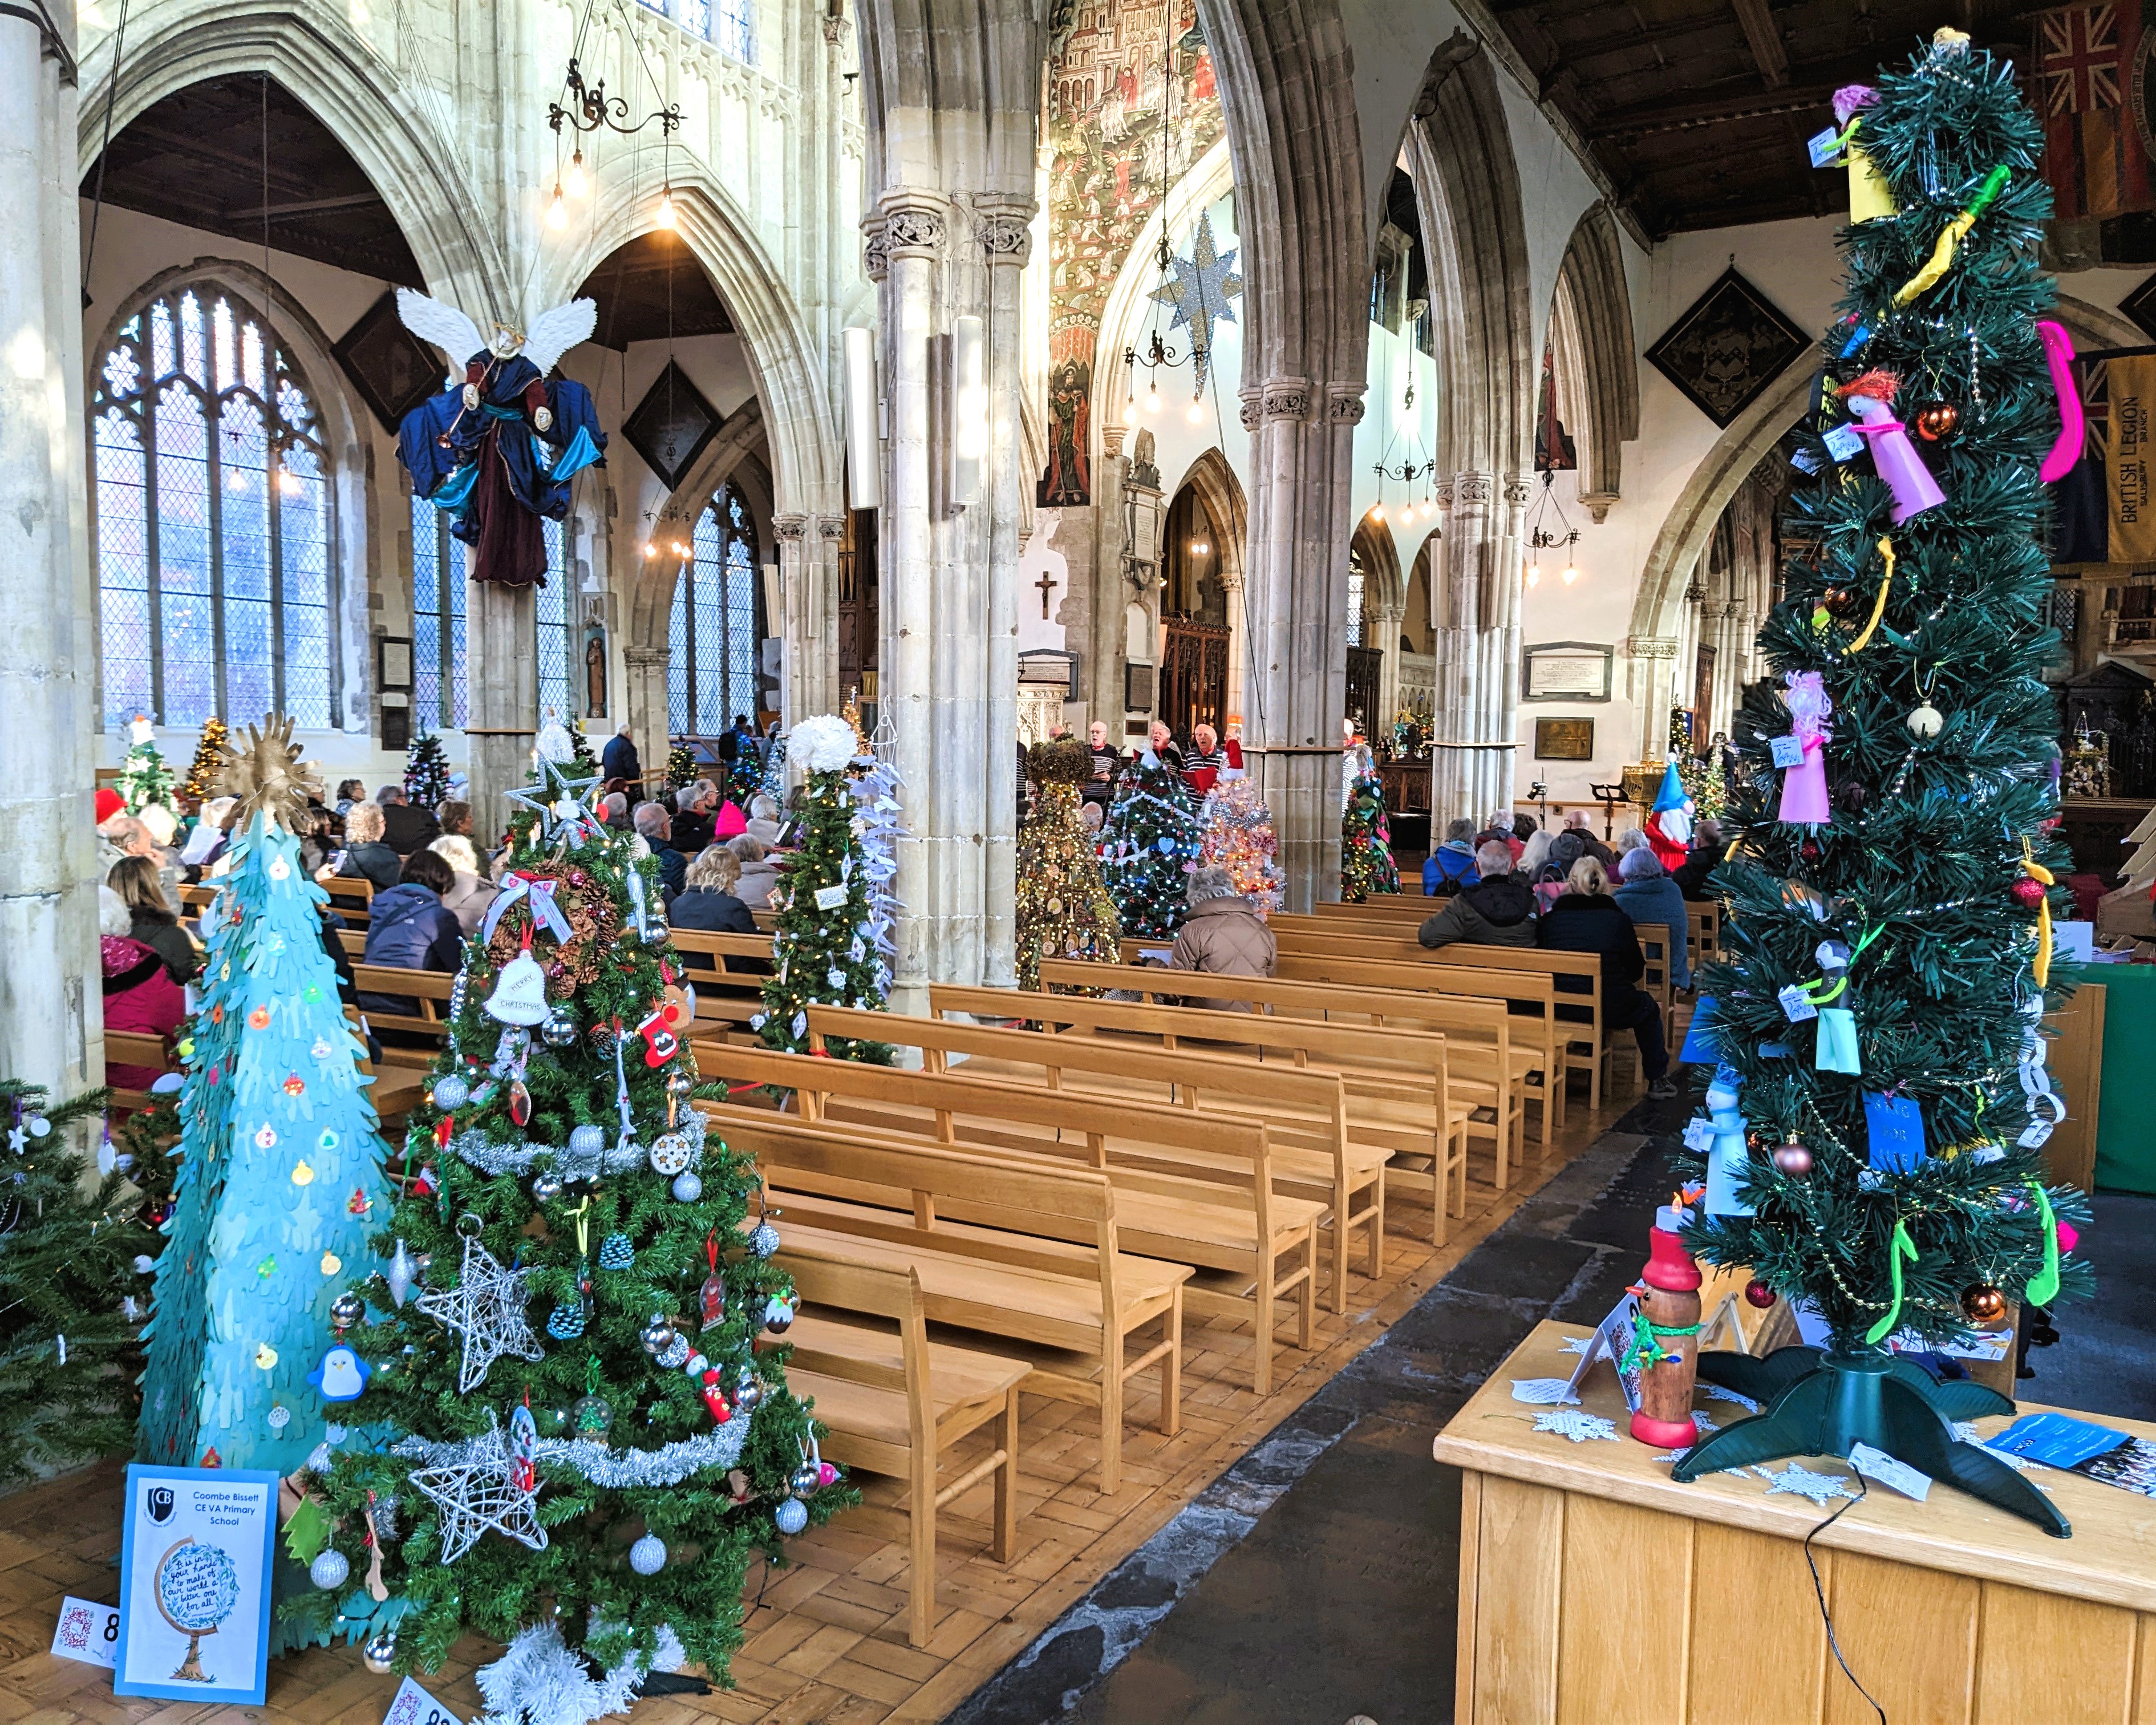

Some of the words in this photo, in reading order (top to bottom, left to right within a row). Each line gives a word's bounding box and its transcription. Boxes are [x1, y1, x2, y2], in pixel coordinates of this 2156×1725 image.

[2119, 396, 2138, 456] LEGION
[2139, 409, 2148, 443] BRANCH
[2139, 460, 2148, 507] SALISBURY
[2119, 463, 2138, 524] BRITISH
[511, 974, 533, 991] MERRY
[500, 1000, 541, 1010] CHRISTMAS
[155, 1490, 172, 1504] CB
[193, 1491, 230, 1501] Coombe
[233, 1493, 259, 1502] Bissett
[224, 1505, 256, 1516] Primary
[210, 1516, 240, 1526] School
[171, 1569, 189, 1584] your
[193, 1558, 217, 1573] hands
[176, 1560, 183, 1570] It
[187, 1573, 206, 1584] make
[207, 1568, 217, 1578] of
[187, 1580, 209, 1592] world
[181, 1592, 200, 1602] better
[187, 1602, 200, 1611] for
[201, 1598, 214, 1607] all
